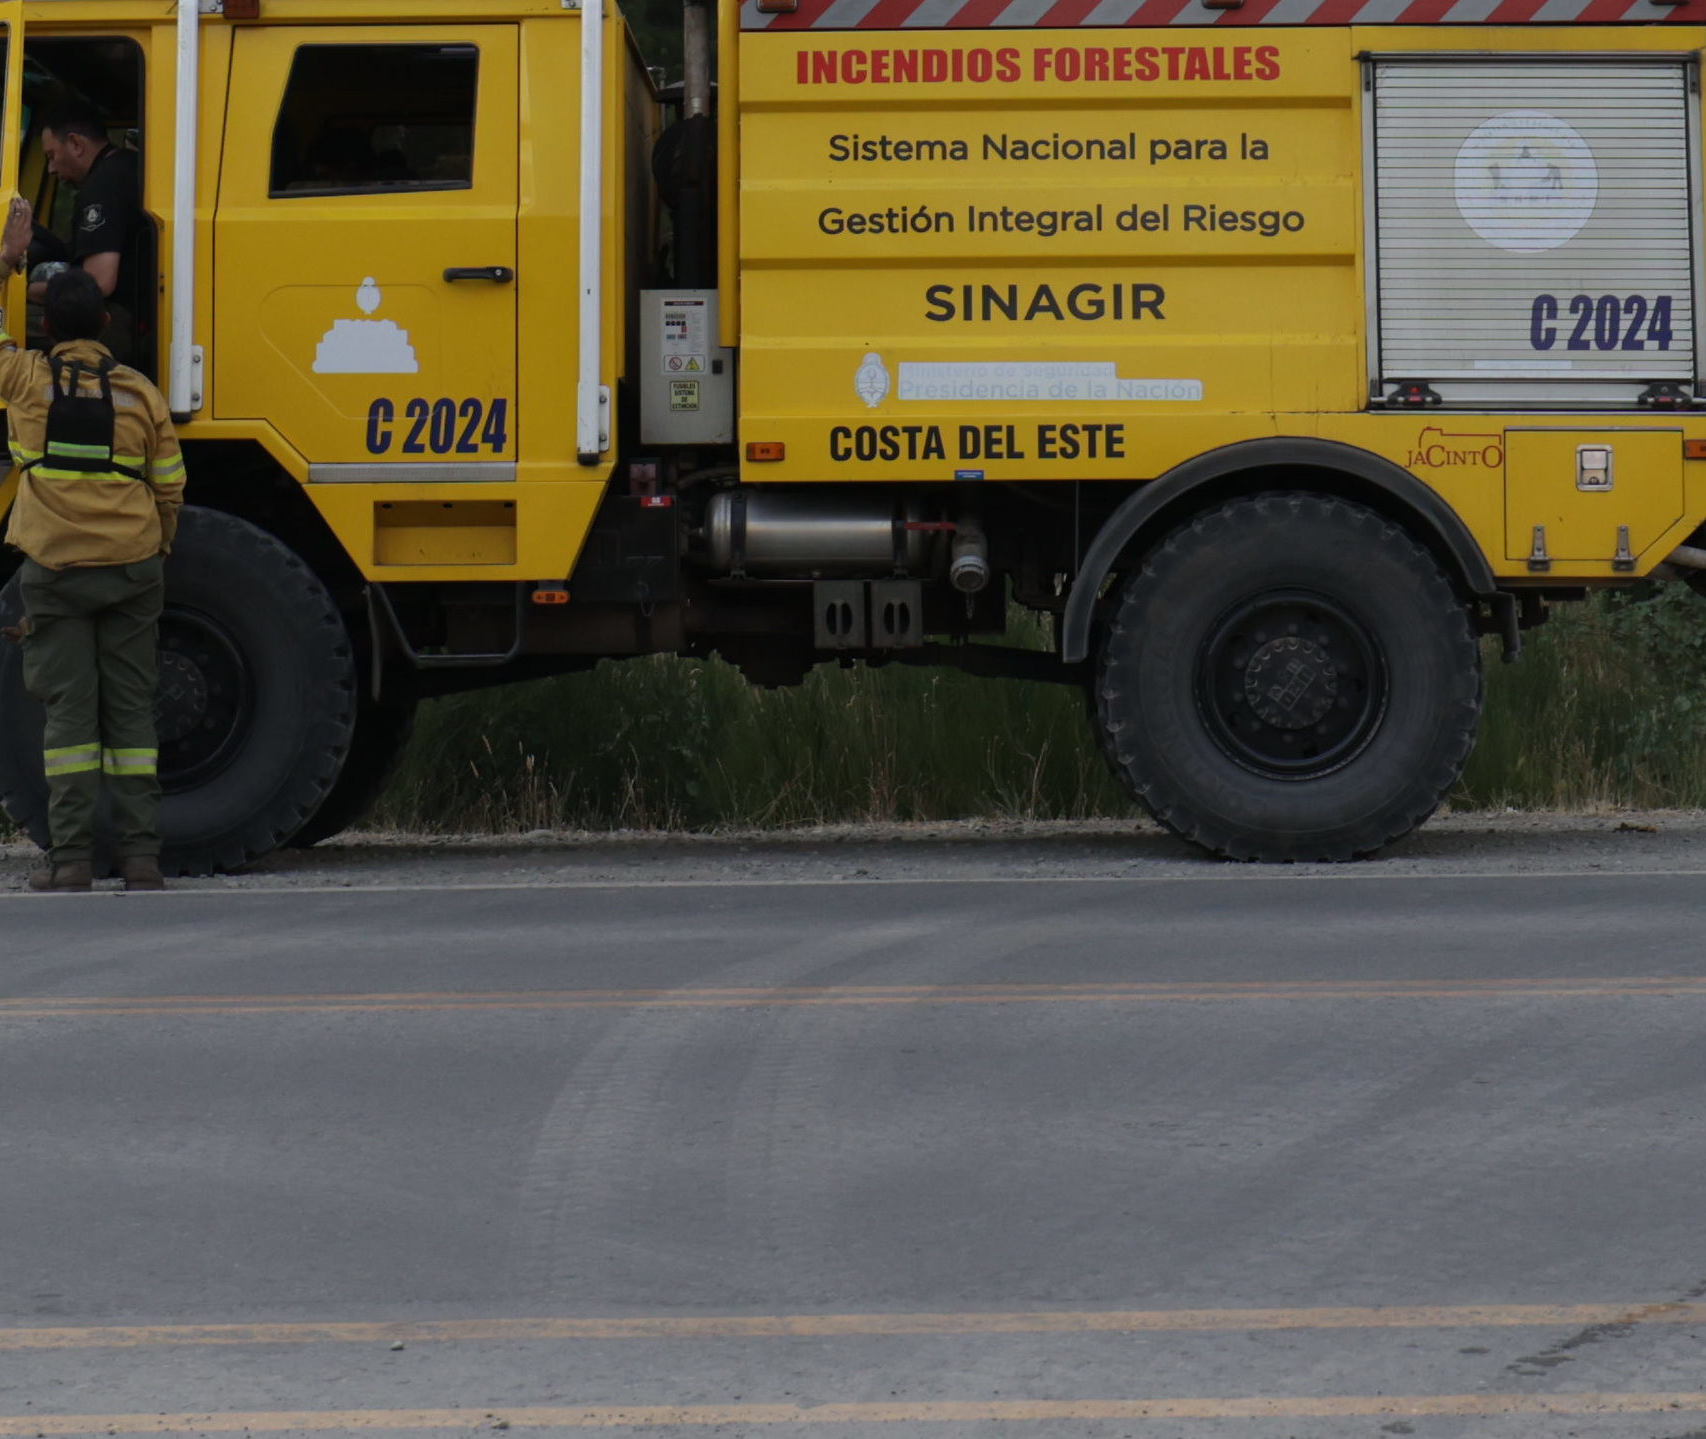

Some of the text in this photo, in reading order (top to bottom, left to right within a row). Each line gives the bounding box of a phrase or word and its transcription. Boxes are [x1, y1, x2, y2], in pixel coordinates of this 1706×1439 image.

[796, 45, 1281, 85] INCENDIOS FORESTALES
[828, 132, 1269, 166] Sistema Nacional para la
[818, 203, 1305, 238] Gestión Integral del Riesgo
[924, 283, 1166, 322] SINAGIR
[1529, 293, 1673, 352] C 2024
[900, 379, 1200, 399] Presidencia de la Nación
[365, 397, 507, 455] C 2024
[829, 423, 1125, 462] COSTA DEL ESTE
